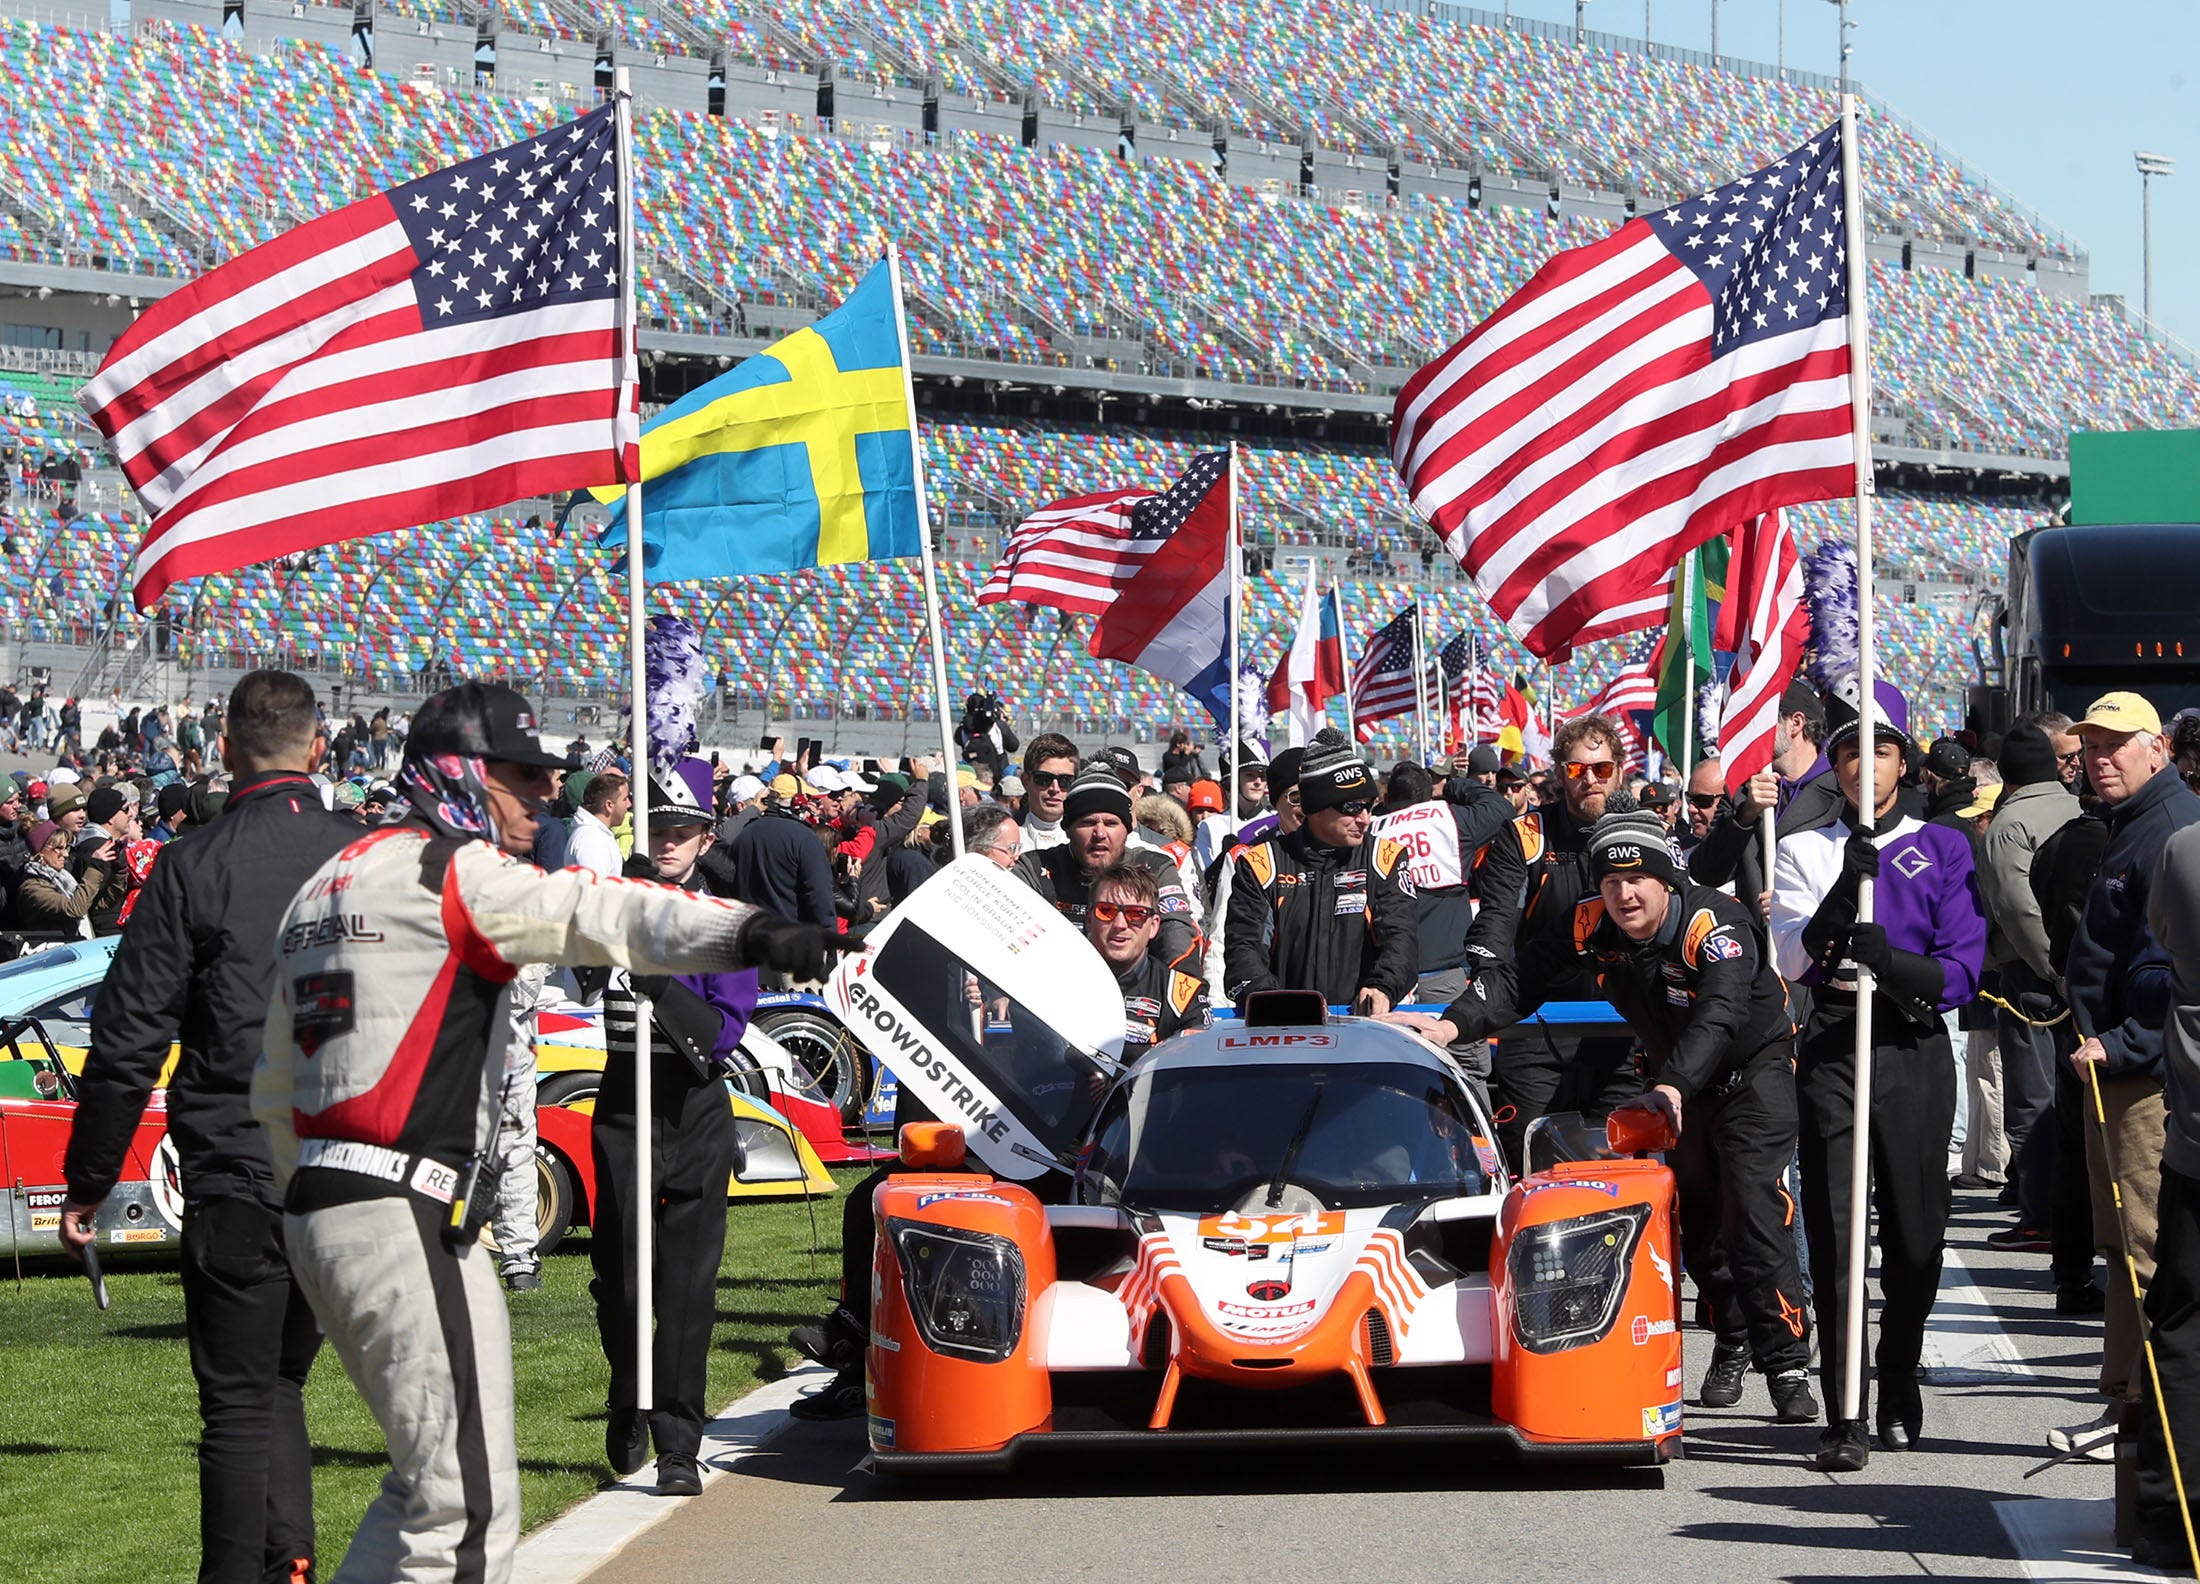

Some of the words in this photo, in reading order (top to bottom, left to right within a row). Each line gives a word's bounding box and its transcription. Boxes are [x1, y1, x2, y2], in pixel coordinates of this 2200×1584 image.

[1333, 766, 1364, 784] aws
[1388, 807, 1444, 827] IMSA
[1388, 831, 1431, 859] 36
[1607, 846, 1641, 860] aws
[1409, 863, 1441, 886] OTO
[952, 878, 982, 905] COLIN
[982, 903, 1015, 934] BRAUN
[1225, 1035, 1330, 1048] LMP3
[848, 983, 1011, 1145] CROWDSTRIKE
[426, 1168, 456, 1192] RE
[33, 1216, 61, 1226] Brita
[1216, 1209, 1328, 1242] 54
[126, 1232, 159, 1241] BORGO
[1221, 1303, 1313, 1317] MOTUL
